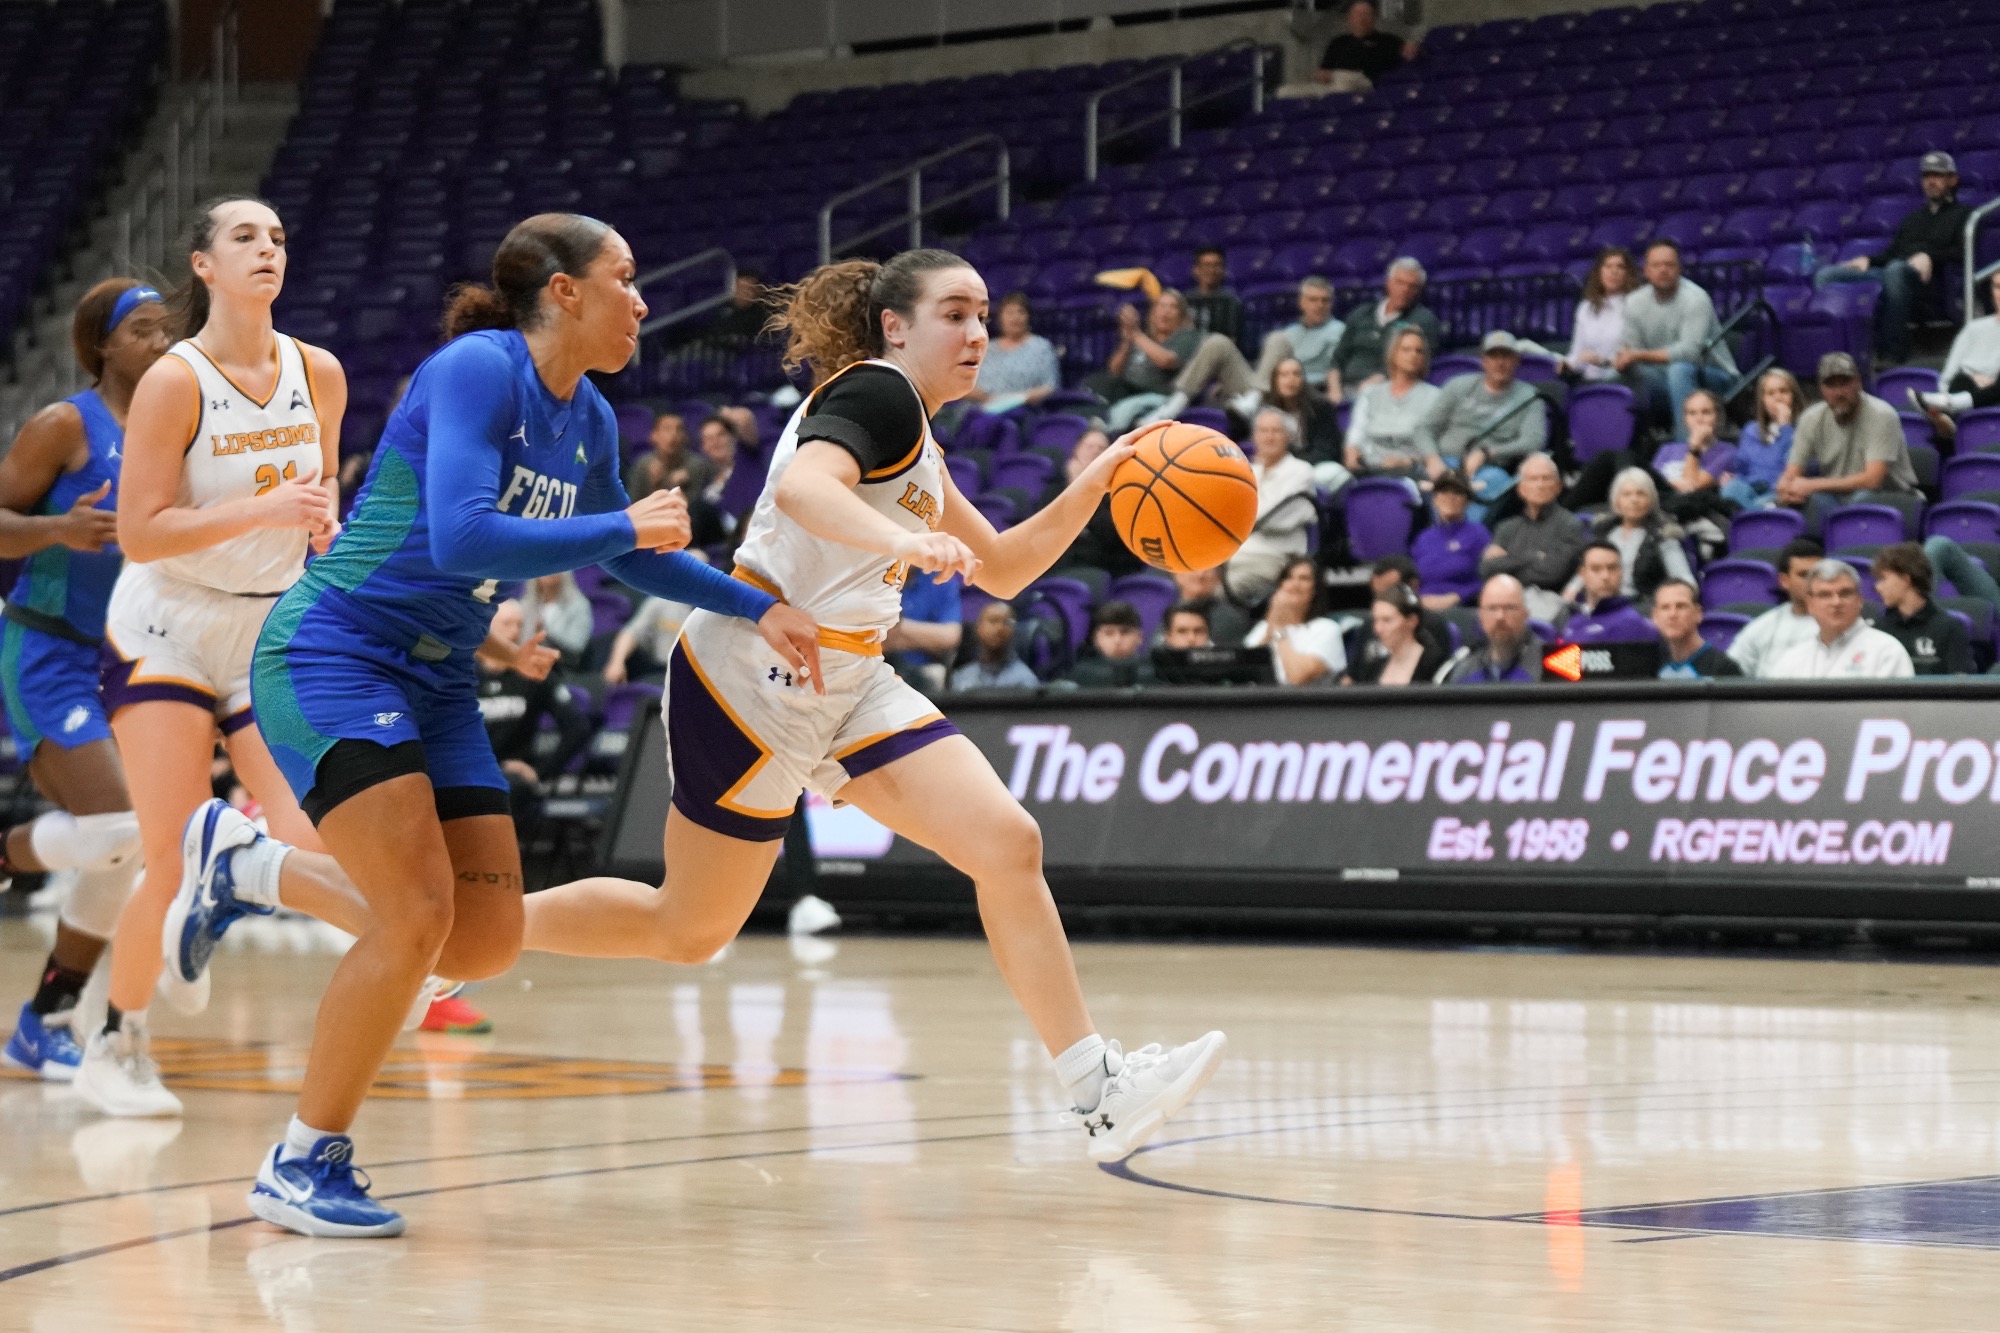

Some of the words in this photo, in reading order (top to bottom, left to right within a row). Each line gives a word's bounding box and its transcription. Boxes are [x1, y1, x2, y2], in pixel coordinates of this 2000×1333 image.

[1007, 725, 1126, 802] The
[1139, 720, 1575, 804] Commercial
[1583, 719, 1827, 803] Fence
[1427, 817, 1494, 860] Est.
[1506, 818, 1590, 861] 1958
[1650, 818, 1953, 865] RGFENCE.COM
